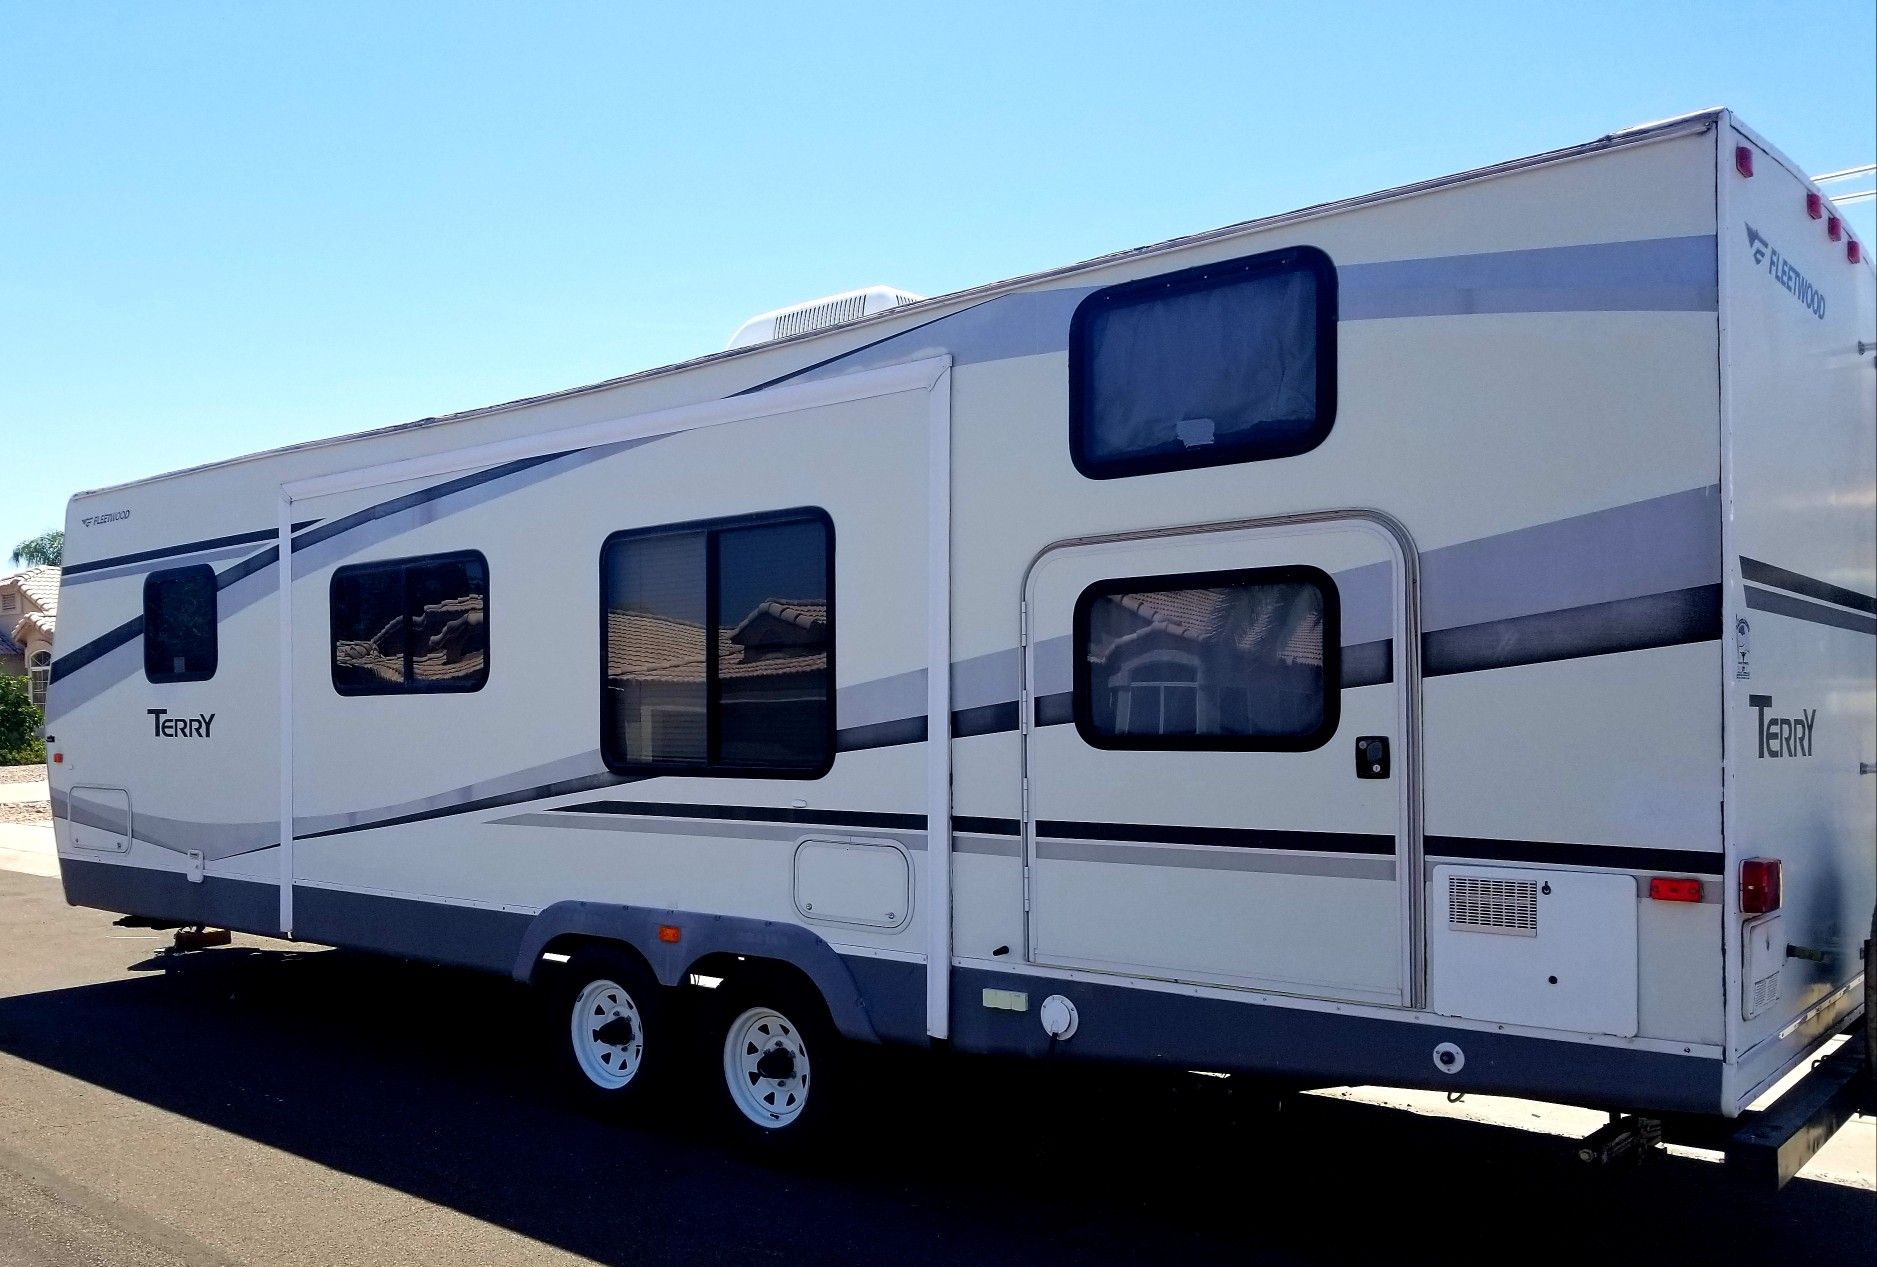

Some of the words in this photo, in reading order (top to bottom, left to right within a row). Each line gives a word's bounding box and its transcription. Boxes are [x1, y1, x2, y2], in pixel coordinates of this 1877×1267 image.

[1768, 246, 1825, 320] FLEETWOOD
[147, 709, 216, 738] TERRY
[1749, 694, 1816, 758] TERRY
